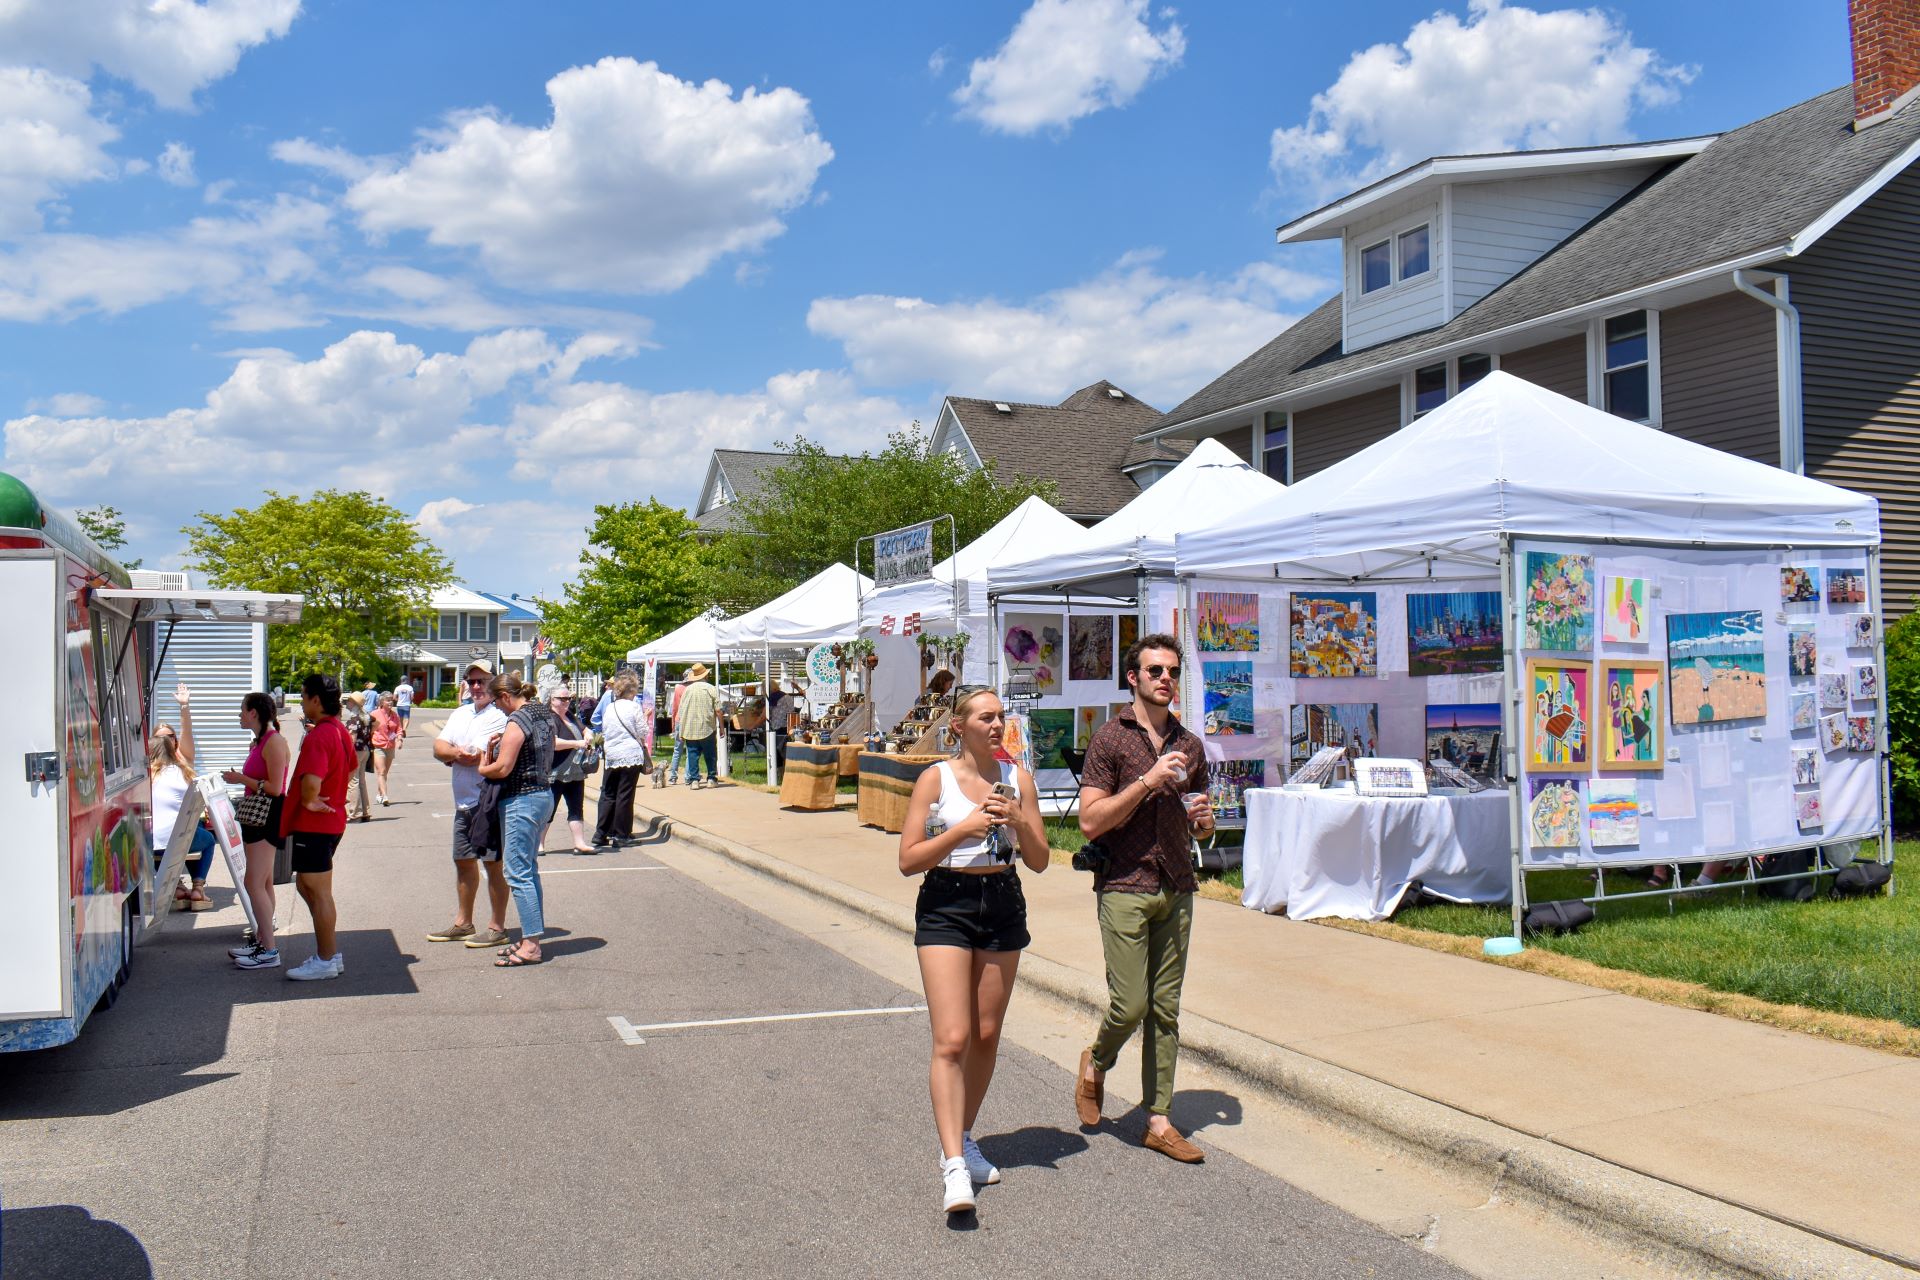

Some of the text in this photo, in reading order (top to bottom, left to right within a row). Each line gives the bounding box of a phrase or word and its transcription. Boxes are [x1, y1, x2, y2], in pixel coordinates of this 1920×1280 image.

[879, 527, 928, 557] POTTERY
[878, 561, 898, 581] MUGS
[905, 553, 929, 577] MORE
